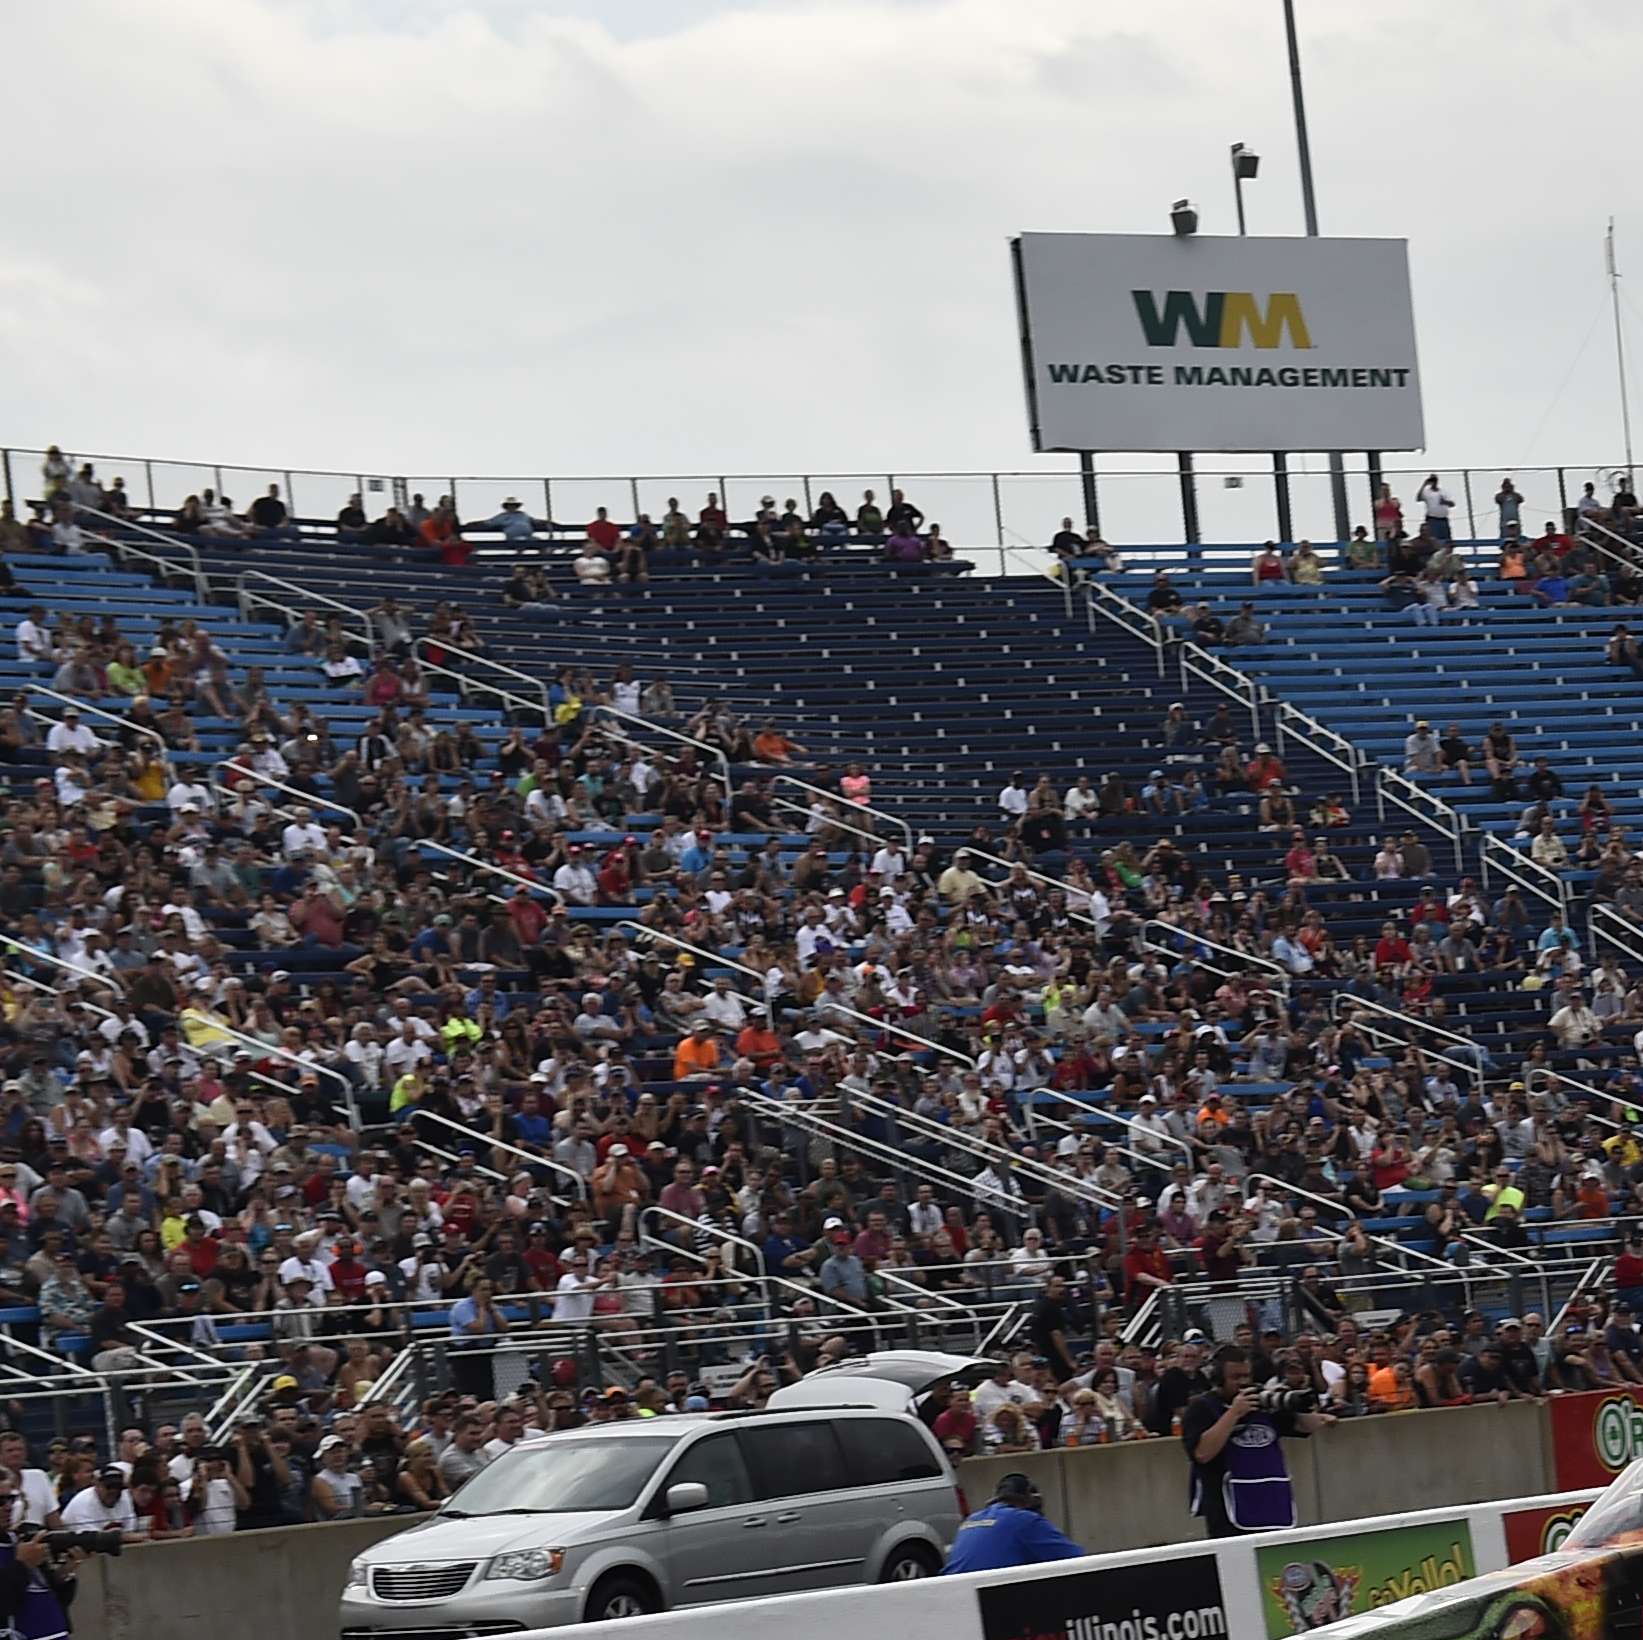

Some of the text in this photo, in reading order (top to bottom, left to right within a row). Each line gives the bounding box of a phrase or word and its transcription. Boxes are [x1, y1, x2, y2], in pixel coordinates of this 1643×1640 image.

[1131, 290, 1312, 348] WM
[1048, 364, 1411, 388] WASTE MANAGEMENT
